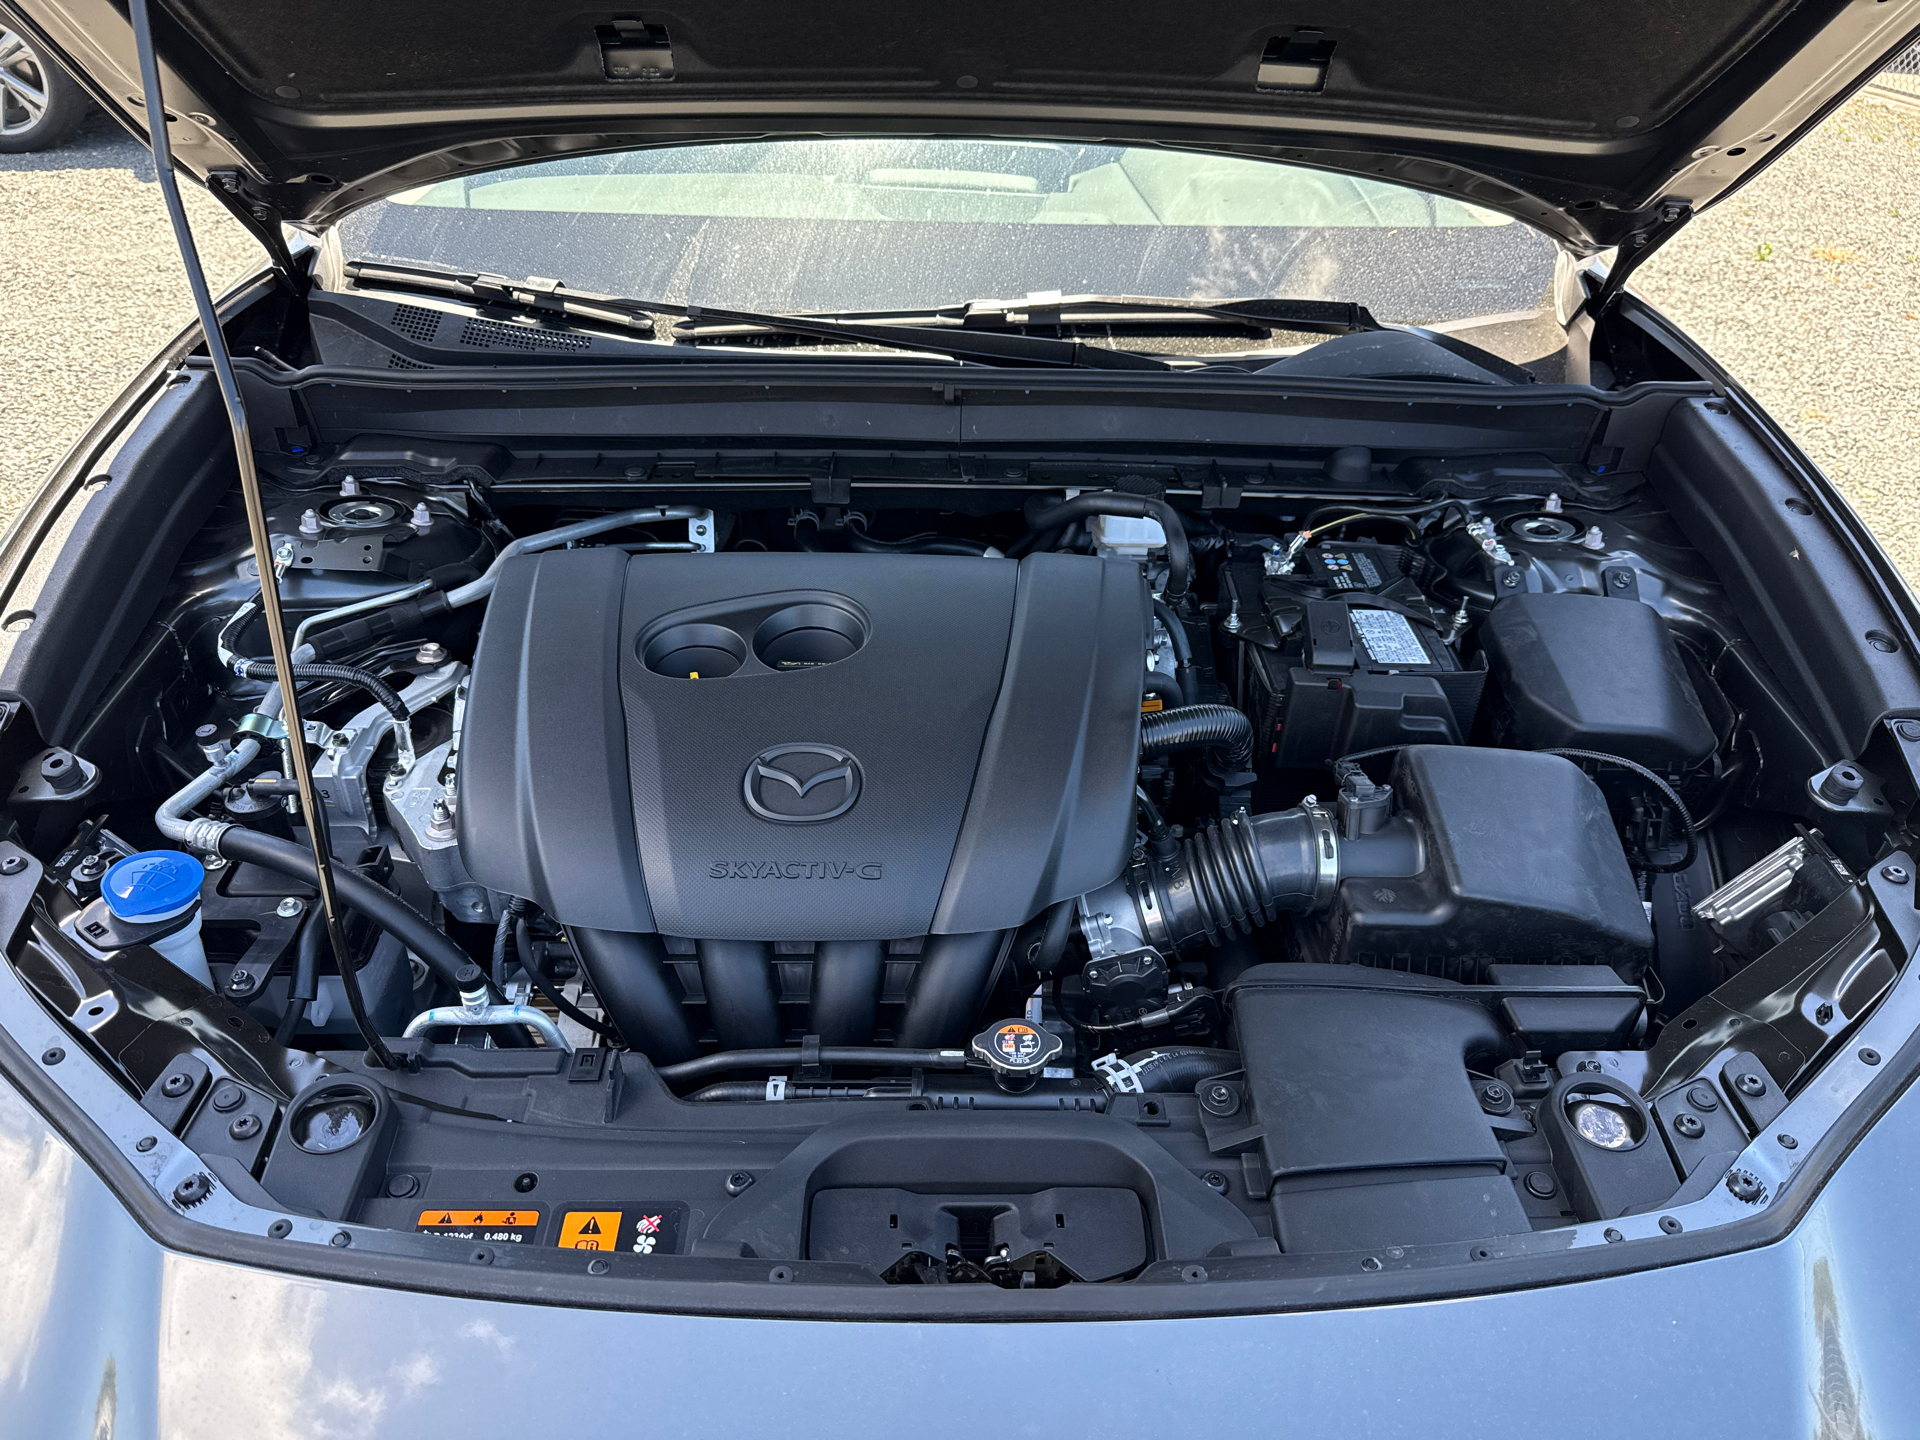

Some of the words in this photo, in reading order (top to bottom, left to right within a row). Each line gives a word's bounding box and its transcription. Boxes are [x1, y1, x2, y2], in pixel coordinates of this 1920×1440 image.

[709, 861, 882, 880] SKYACTIV-G
[484, 1232, 509, 1241] 0.480
[510, 1232, 523, 1242] kg
